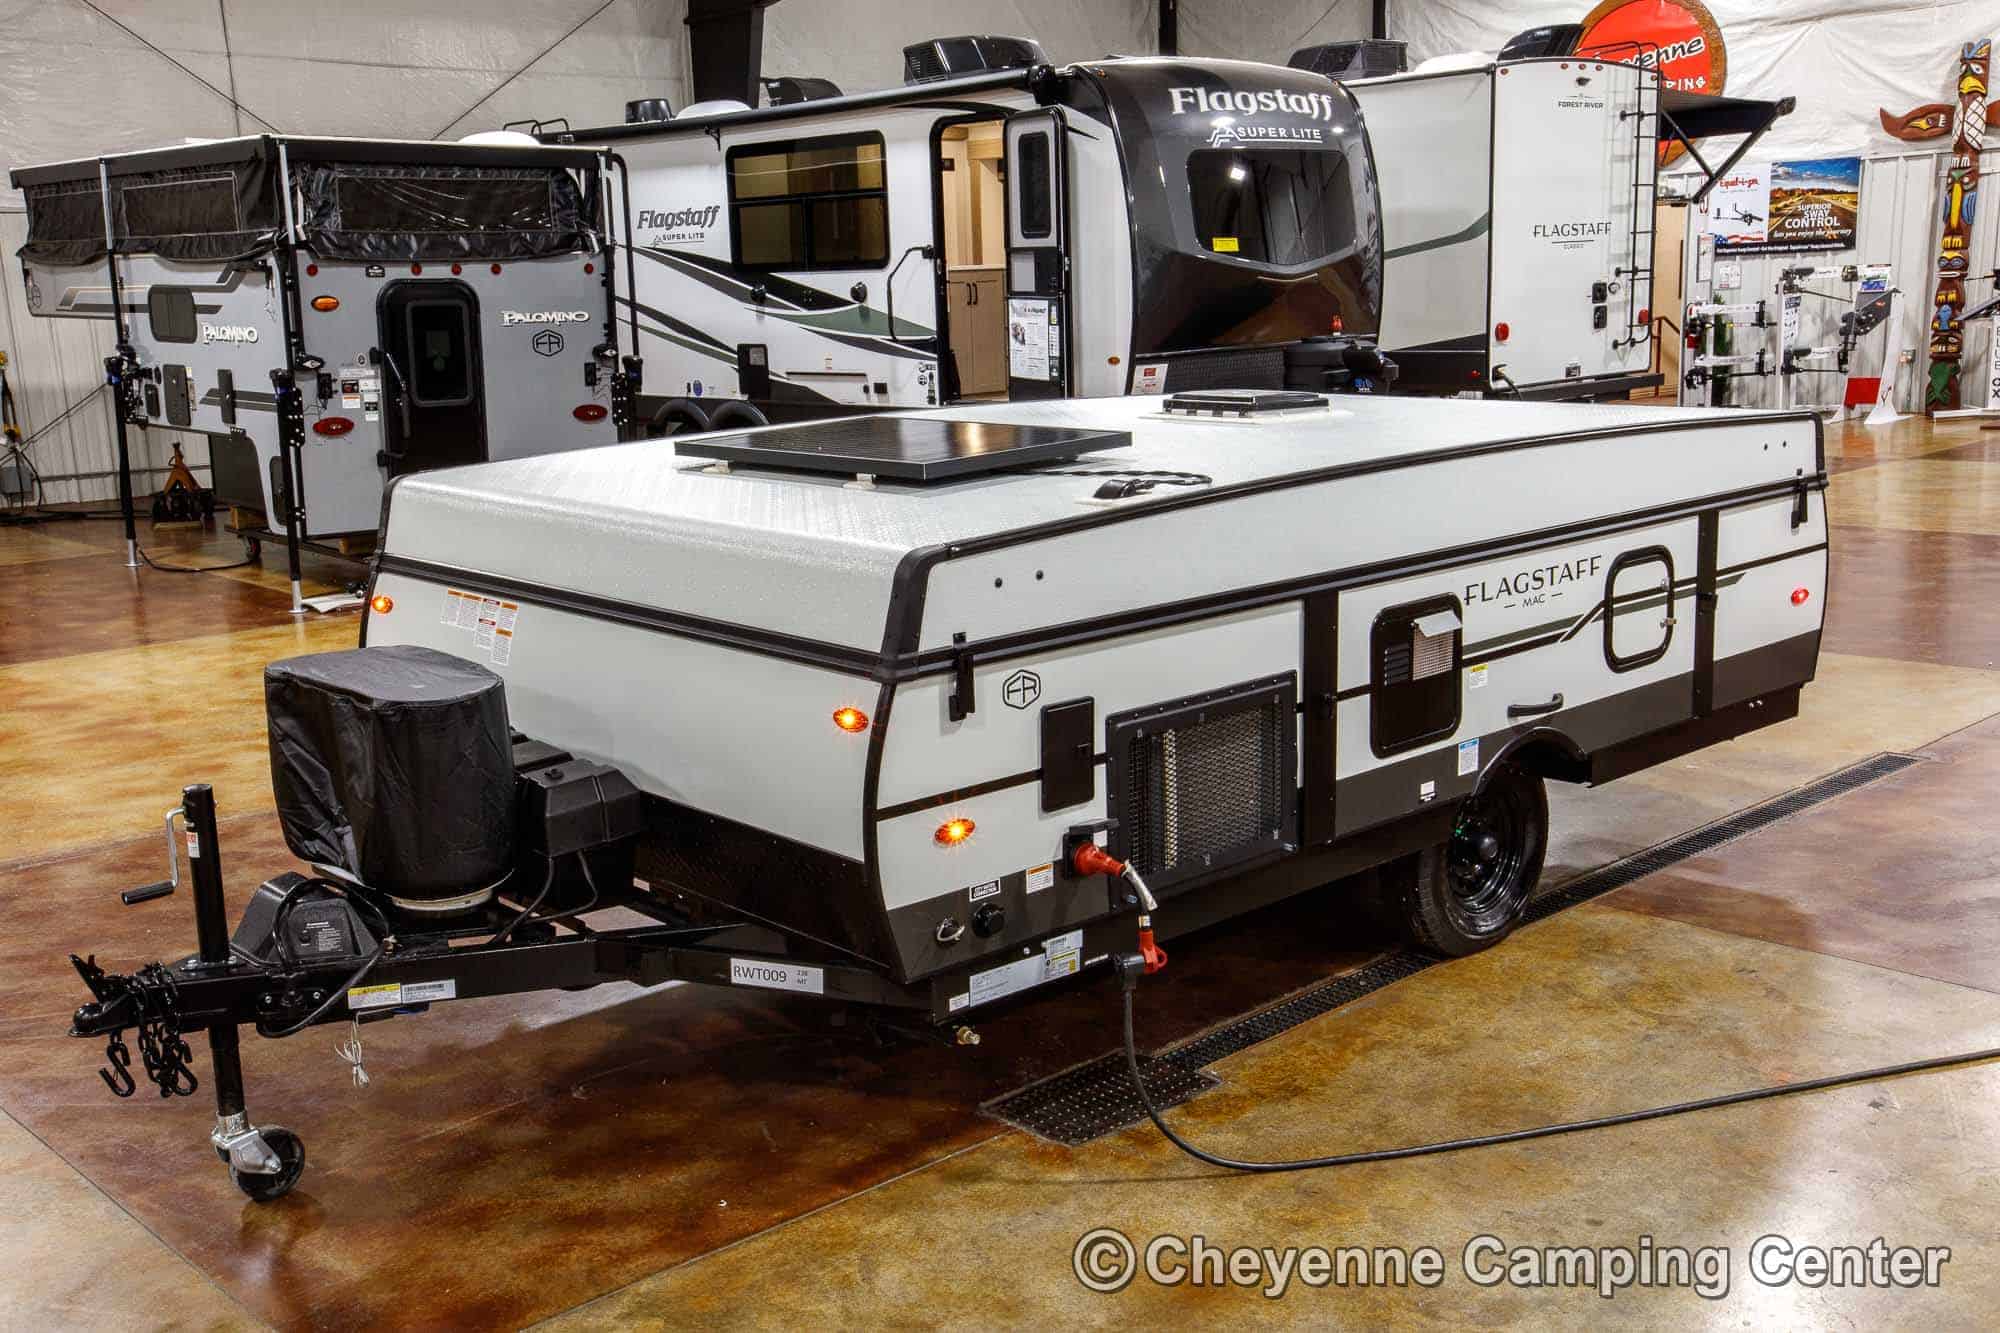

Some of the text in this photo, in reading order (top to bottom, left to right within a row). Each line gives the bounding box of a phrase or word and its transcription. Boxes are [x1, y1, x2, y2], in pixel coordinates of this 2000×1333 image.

[1168, 86, 1332, 121] Flagstaff
[1238, 127, 1322, 139] SUPER LITE
[637, 205, 720, 230] Flagstaff
[1804, 210, 1829, 218] SWAY
[1533, 222, 1612, 238] FLAGSTAFF
[1785, 216, 1840, 229] CONTROL
[662, 232, 704, 241] SUPER LITE
[500, 310, 591, 326] PALOMINO
[1464, 555, 1602, 605] FLAGSTAFF
[1522, 594, 1546, 607] MAC
[734, 966, 787, 982] RWT009
